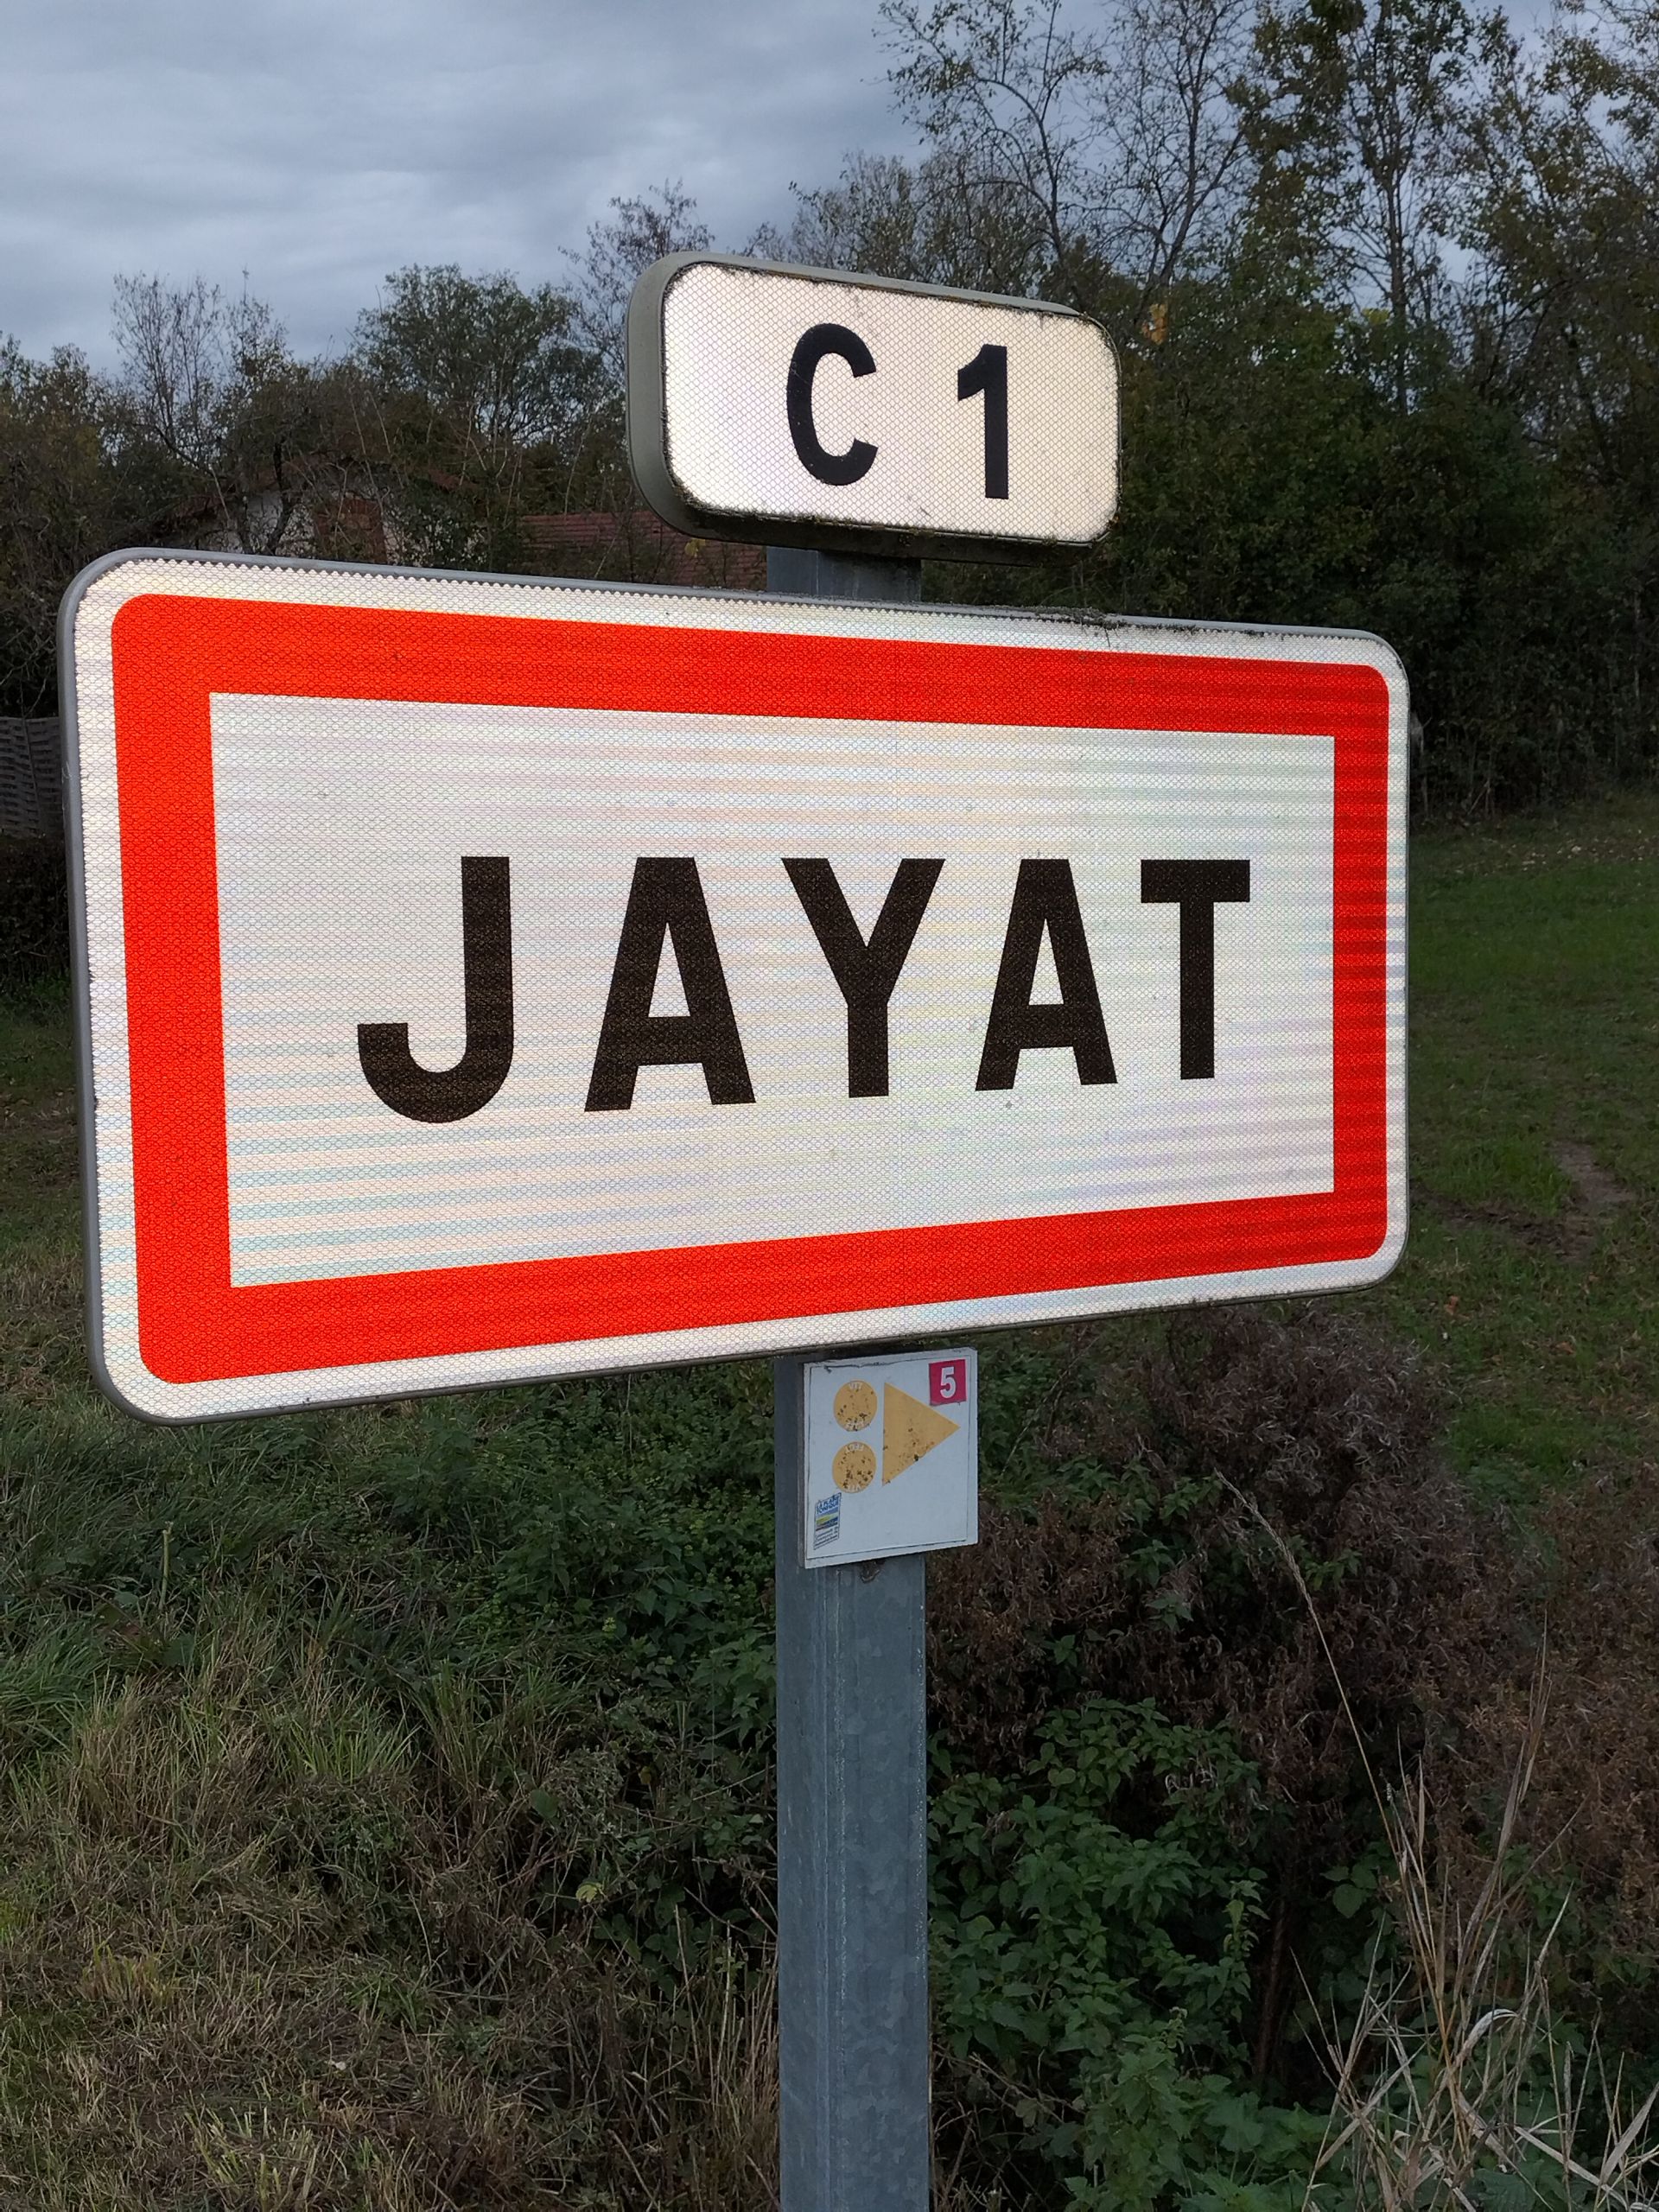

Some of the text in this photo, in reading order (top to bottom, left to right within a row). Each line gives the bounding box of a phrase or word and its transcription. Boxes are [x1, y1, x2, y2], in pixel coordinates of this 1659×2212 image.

[786, 322, 1009, 500] C 1
[357, 855, 1251, 1124] JAYAT
[940, 1366, 957, 1399] 5
